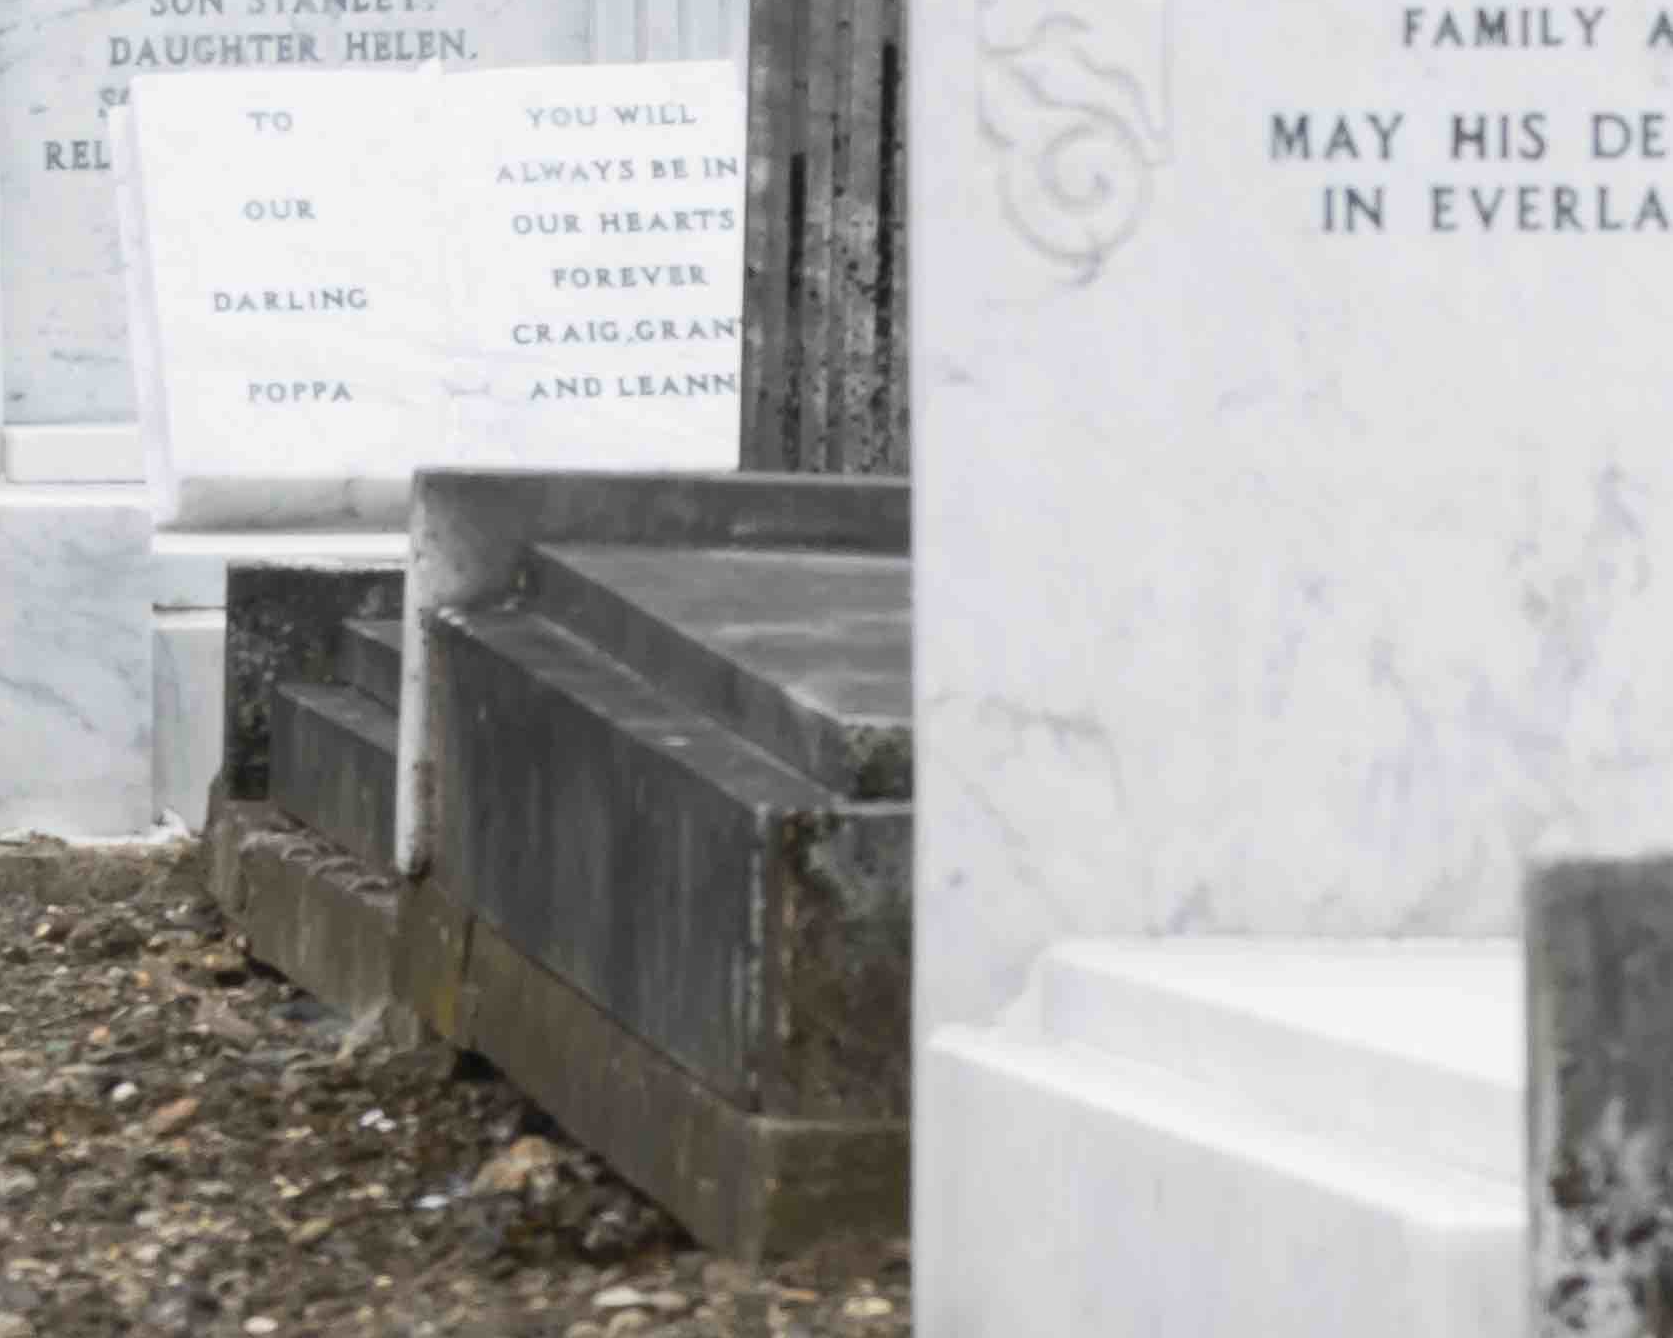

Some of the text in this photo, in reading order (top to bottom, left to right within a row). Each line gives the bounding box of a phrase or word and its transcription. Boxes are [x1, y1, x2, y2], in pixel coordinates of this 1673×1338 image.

[1403, 6, 1604, 47] FAMILY
[110, 32, 320, 67] DAUGHTER
[248, 111, 293, 133] TO
[526, 104, 698, 127] YOU WILL
[1270, 114, 1404, 161] MAY
[1450, 113, 1548, 161] HIS
[495, 156, 738, 183] ALWAYS BE IN
[245, 199, 315, 220] OUR
[1324, 185, 1670, 233] IN EVERLA
[511, 209, 735, 235] OUR HEARTS
[552, 265, 709, 289] FOREVER
[213, 289, 369, 313] DARLING
[248, 381, 352, 403] POPPA
[530, 377, 601, 401] AND
